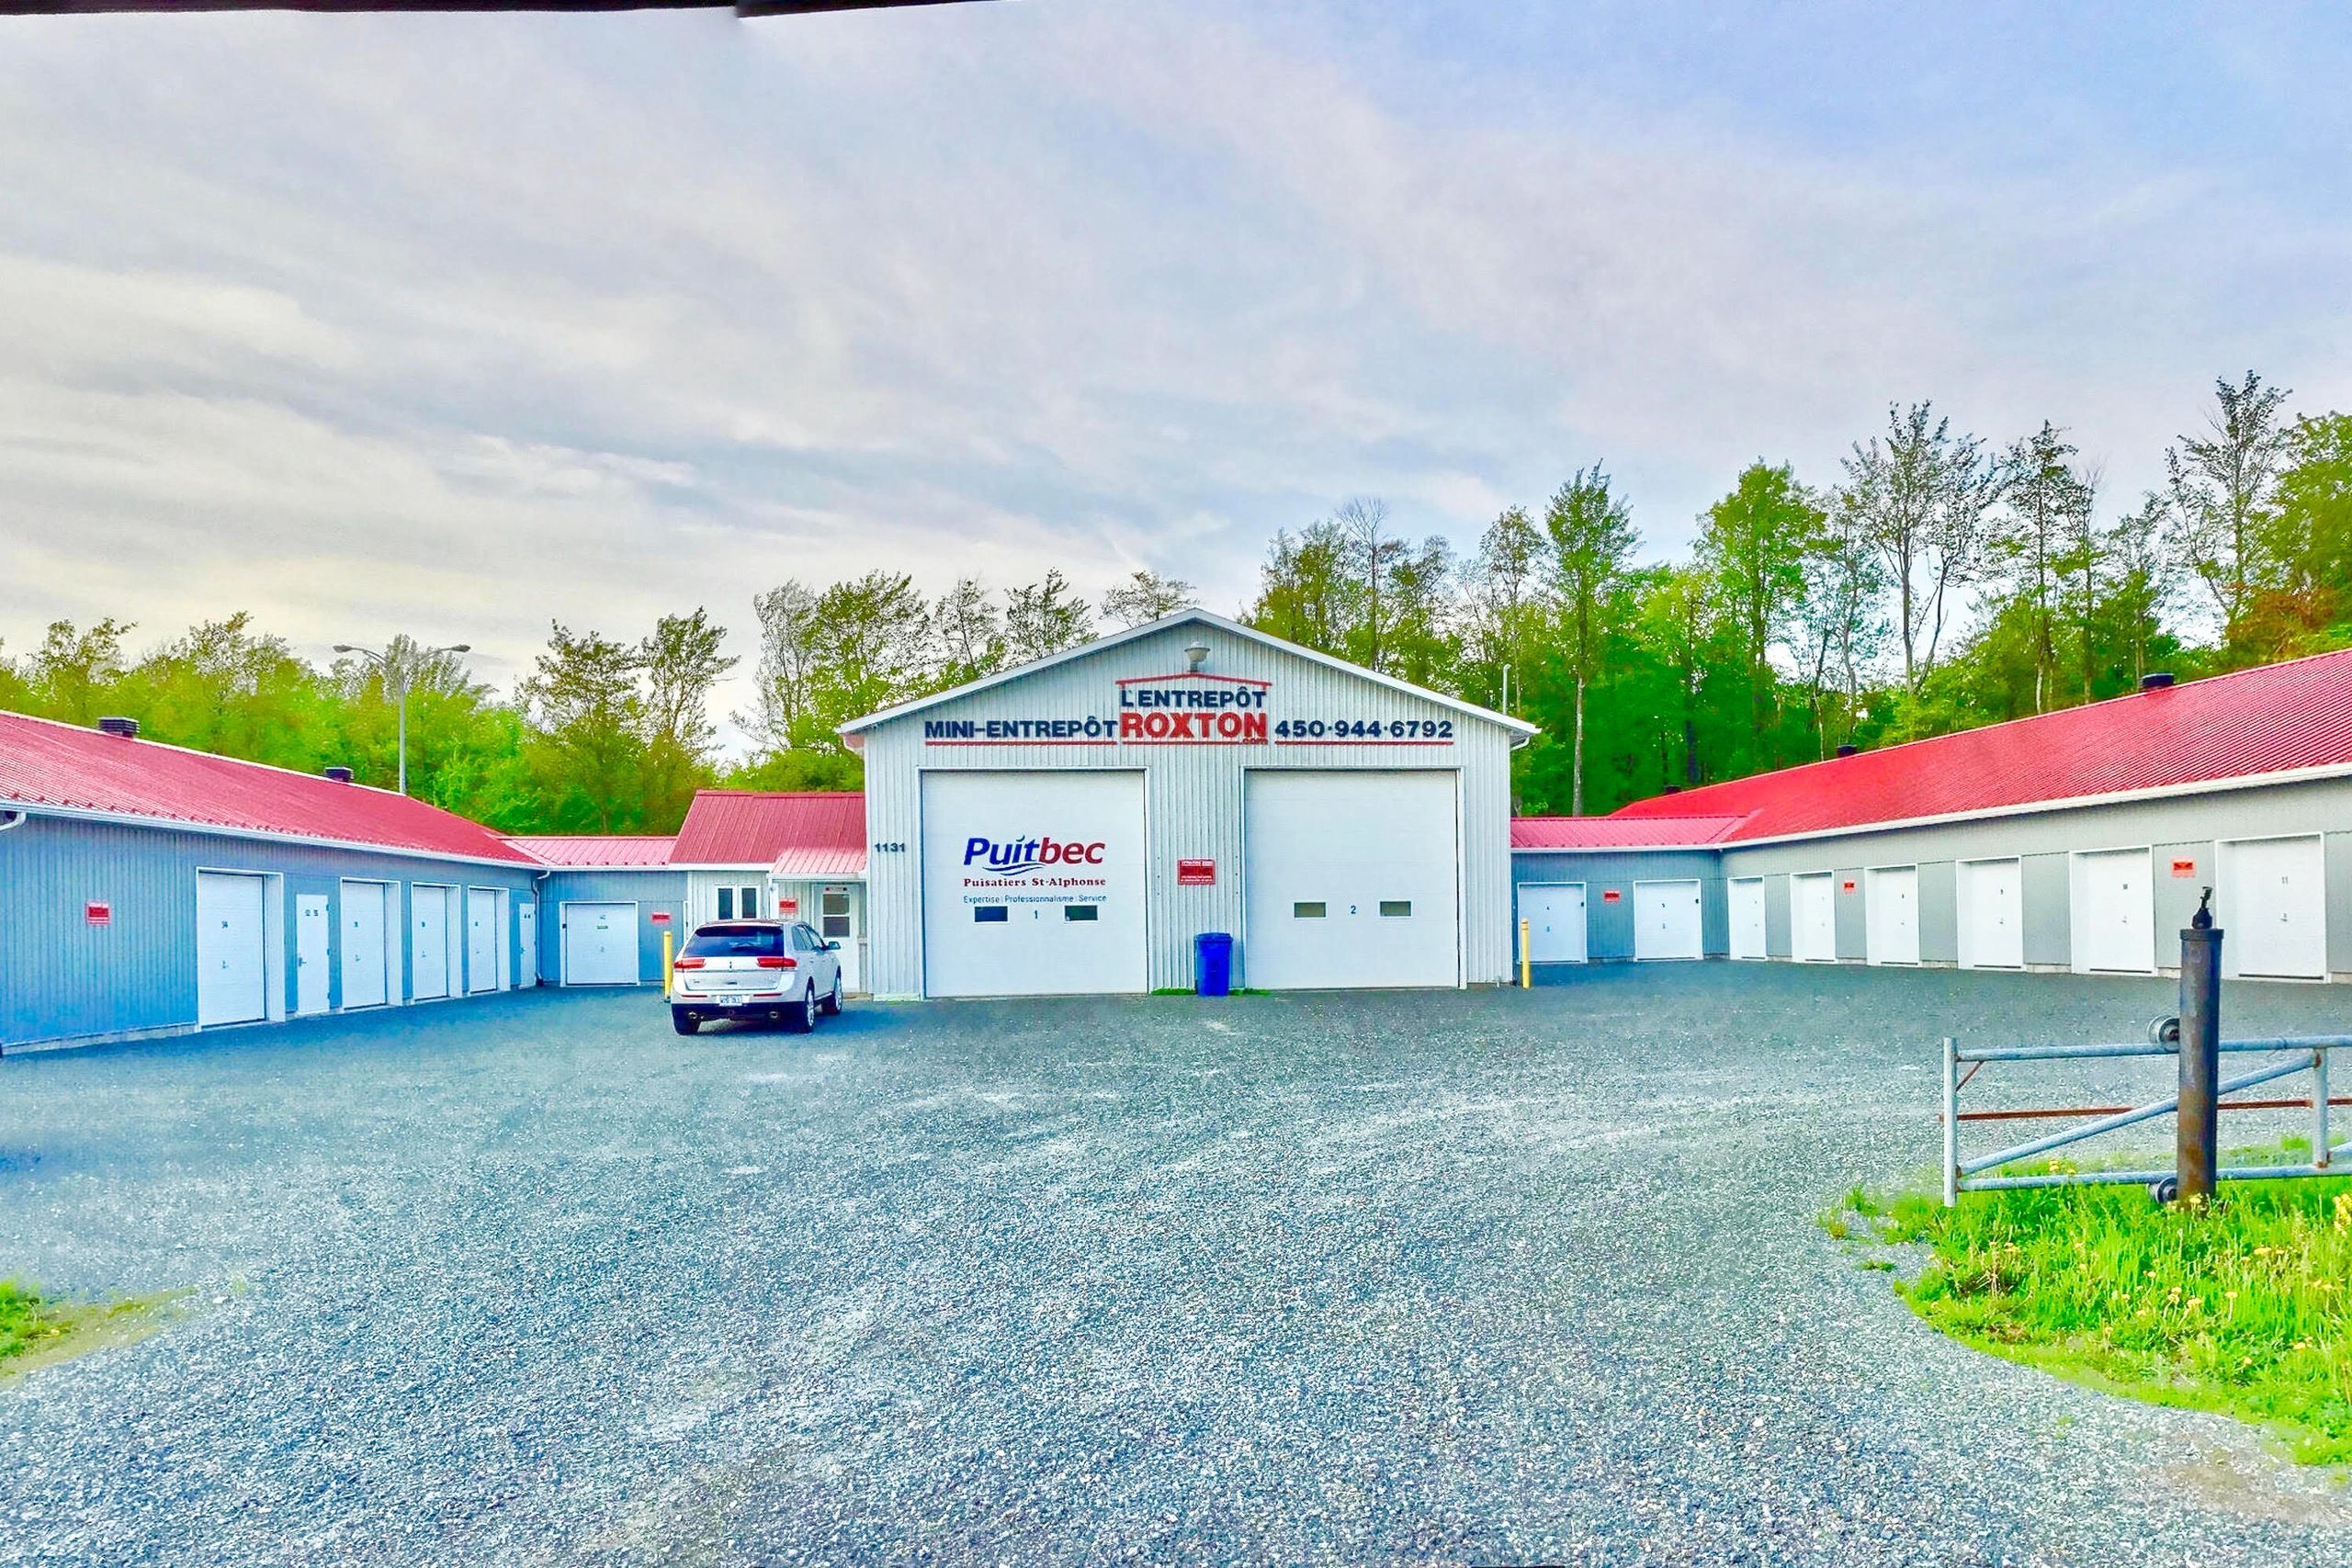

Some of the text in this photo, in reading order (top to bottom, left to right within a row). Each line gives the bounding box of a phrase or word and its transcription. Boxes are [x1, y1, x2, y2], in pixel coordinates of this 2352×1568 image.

[1121, 686, 1266, 707] L'ENTREPÔT
[924, 716, 1118, 739] MINI-ENTREPÔT
[1121, 712, 1267, 738] ROXTON
[875, 842, 905, 852] 1131
[964, 835, 1105, 865] Puitbec
[964, 877, 1106, 887] Puisatiers St-Alphonse
[964, 896, 1000, 904] Expertise
[1005, 895, 1073, 903] Professionnalisme
[1034, 909, 1038, 919] 1
[1351, 906, 1357, 914] 2
